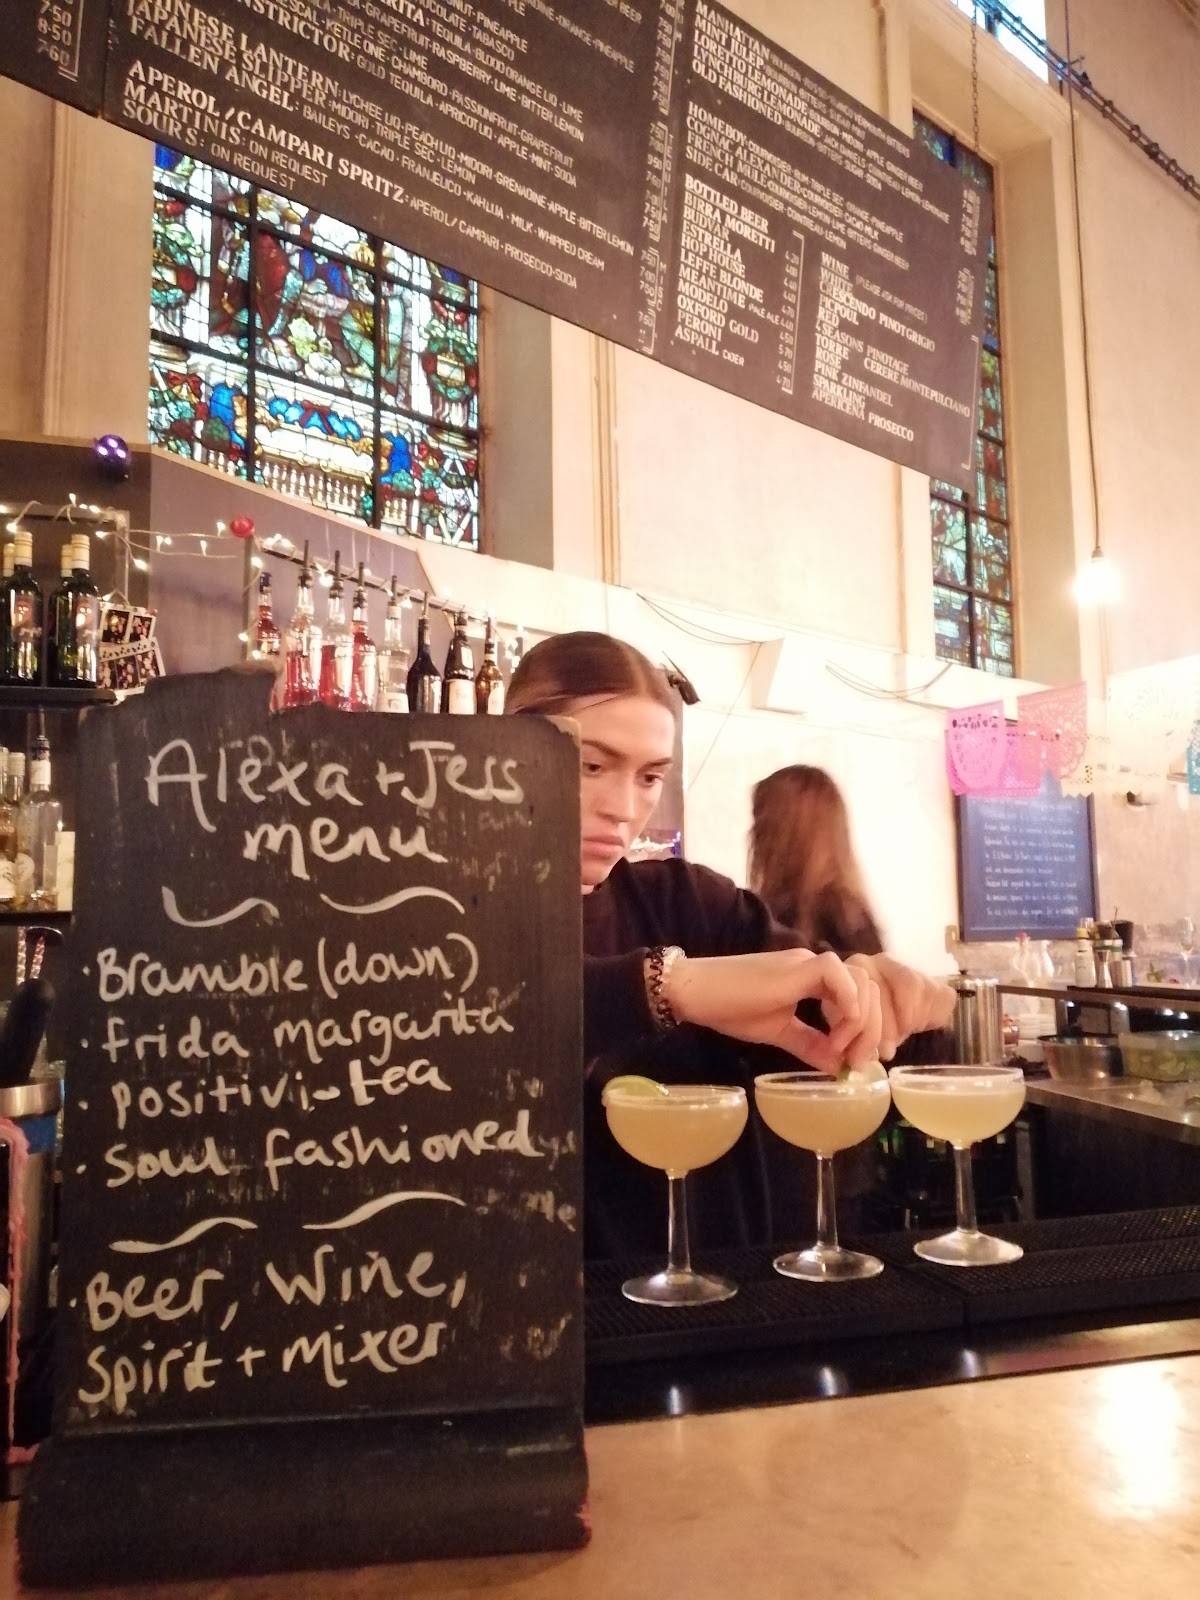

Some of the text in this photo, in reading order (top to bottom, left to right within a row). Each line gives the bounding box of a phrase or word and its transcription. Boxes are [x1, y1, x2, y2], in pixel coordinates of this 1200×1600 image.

[403, 45, 428, 71] LIME
[430, 18, 471, 55] TEQUILA
[474, 46, 504, 75] BLOOD
[505, 65, 542, 99] ORANGE
[471, 24, 514, 62] TABASCO
[477, 9, 527, 53] PINEAPPLE
[694, 12, 764, 74] MINT JULEP
[695, 0, 769, 61] MANHATTAN
[364, 0, 429, 51] GRAPEFRUIT
[431, 40, 490, 86] RASPBERRY
[494, 77, 517, 102] LIME
[521, 93, 553, 124] BITTER
[553, 114, 584, 143] LEMON
[691, 57, 717, 85] OLD
[719, 74, 782, 127] FASHIONED
[692, 42, 761, 100] LYNCHBURG
[763, 89, 820, 138] LEMONADE
[693, 27, 746, 75] LORETTO
[747, 64, 808, 116] LEMONADE
[356, 53, 386, 81] GOLD
[389, 71, 434, 108] TEQUILA
[439, 99, 478, 132] APRICOT
[497, 132, 528, 161] APPLE
[530, 151, 550, 173] MINT
[554, 165, 576, 188] SODA
[362, 37, 386, 63] ONE
[391, 53, 448, 98] CHAMBORD
[451, 88, 518, 138] PASSIONFRUIT
[520, 128, 573, 170] GRAPEFRUIT
[688, 100, 746, 148] HOMEBOY
[130, 13, 219, 76] FALLEN
[302, 103, 350, 140] BAILEYS
[466, 189, 504, 219] KAHLUA
[510, 213, 533, 235] MILK
[537, 226, 576, 257] WHIPPED
[577, 246, 605, 272] CREAM
[211, 141, 230, 162] ON
[233, 151, 296, 192] REQUEST
[248, 137, 268, 160] ON
[271, 148, 328, 187] REQUEST
[331, 98, 369, 130] MIDORI
[375, 121, 410, 151] TRIPLE
[414, 141, 435, 164] SEC
[440, 155, 475, 185] LEMON
[341, 87, 382, 122] LYCHEE
[404, 121, 438, 151] PEACH
[459, 150, 492, 180] MIDORI
[495, 170, 546, 209] GRENADINE
[548, 198, 576, 225] APPLE
[578, 215, 606, 241] BITTER
[607, 230, 634, 256] LEMON
[685, 144, 712, 172] SIDE
[714, 160, 738, 186] CAR
[686, 114, 733, 154] COGNAC
[734, 143, 800, 194] ALEXANDER
[687, 129, 734, 168] FRENCH
[736, 158, 767, 189] MULE
[683, 204, 729, 241] BUDVAR
[684, 190, 722, 224] BIRRA
[724, 213, 775, 254] MORETTI
[685, 173, 738, 216] BOTTLED
[740, 205, 768, 233] BEER
[504, 242, 553, 277] PROSECCO
[554, 267, 577, 288] SODA
[681, 232, 746, 279] HOP HOUSE
[682, 218, 742, 263] ESTRELLA
[820, 251, 849, 278] WINE
[677, 277, 728, 314] MODELO
[678, 262, 746, 309] MEANTIME
[766, 310, 779, 325] ALE
[680, 247, 763, 303] LEFFE BLONDE
[820, 266, 852, 294] WHITE
[676, 292, 759, 344] OXFORD GOLD
[677, 308, 721, 341] PERONI
[817, 305, 839, 328] RED
[819, 293, 859, 326] PICPOUL
[819, 278, 935, 353] CRESCENDO PINOT GRIGIO
[674, 323, 744, 367] ASPALL CIDER
[821, 322, 863, 354] SEASONS
[866, 344, 909, 376] PINOTAGE
[812, 373, 865, 408] SPARKLING
[814, 359, 894, 407] PINK ZINFANDEL
[815, 332, 970, 419] TORRE CERERE MONTEPULCIANO
[867, 411, 914, 442] PROSECCO
[145, 738, 364, 833] Alexa
[401, 740, 524, 809] Jess
[243, 816, 448, 880] menu
[96, 932, 479, 1002] Bramble (down)
[102, 992, 514, 1066] frida margarita
[112, 1059, 452, 1130] positivi-tea
[264, 1110, 545, 1191] fashioned
[85, 1271, 240, 1332] Beer,
[238, 1345, 265, 1378] +
